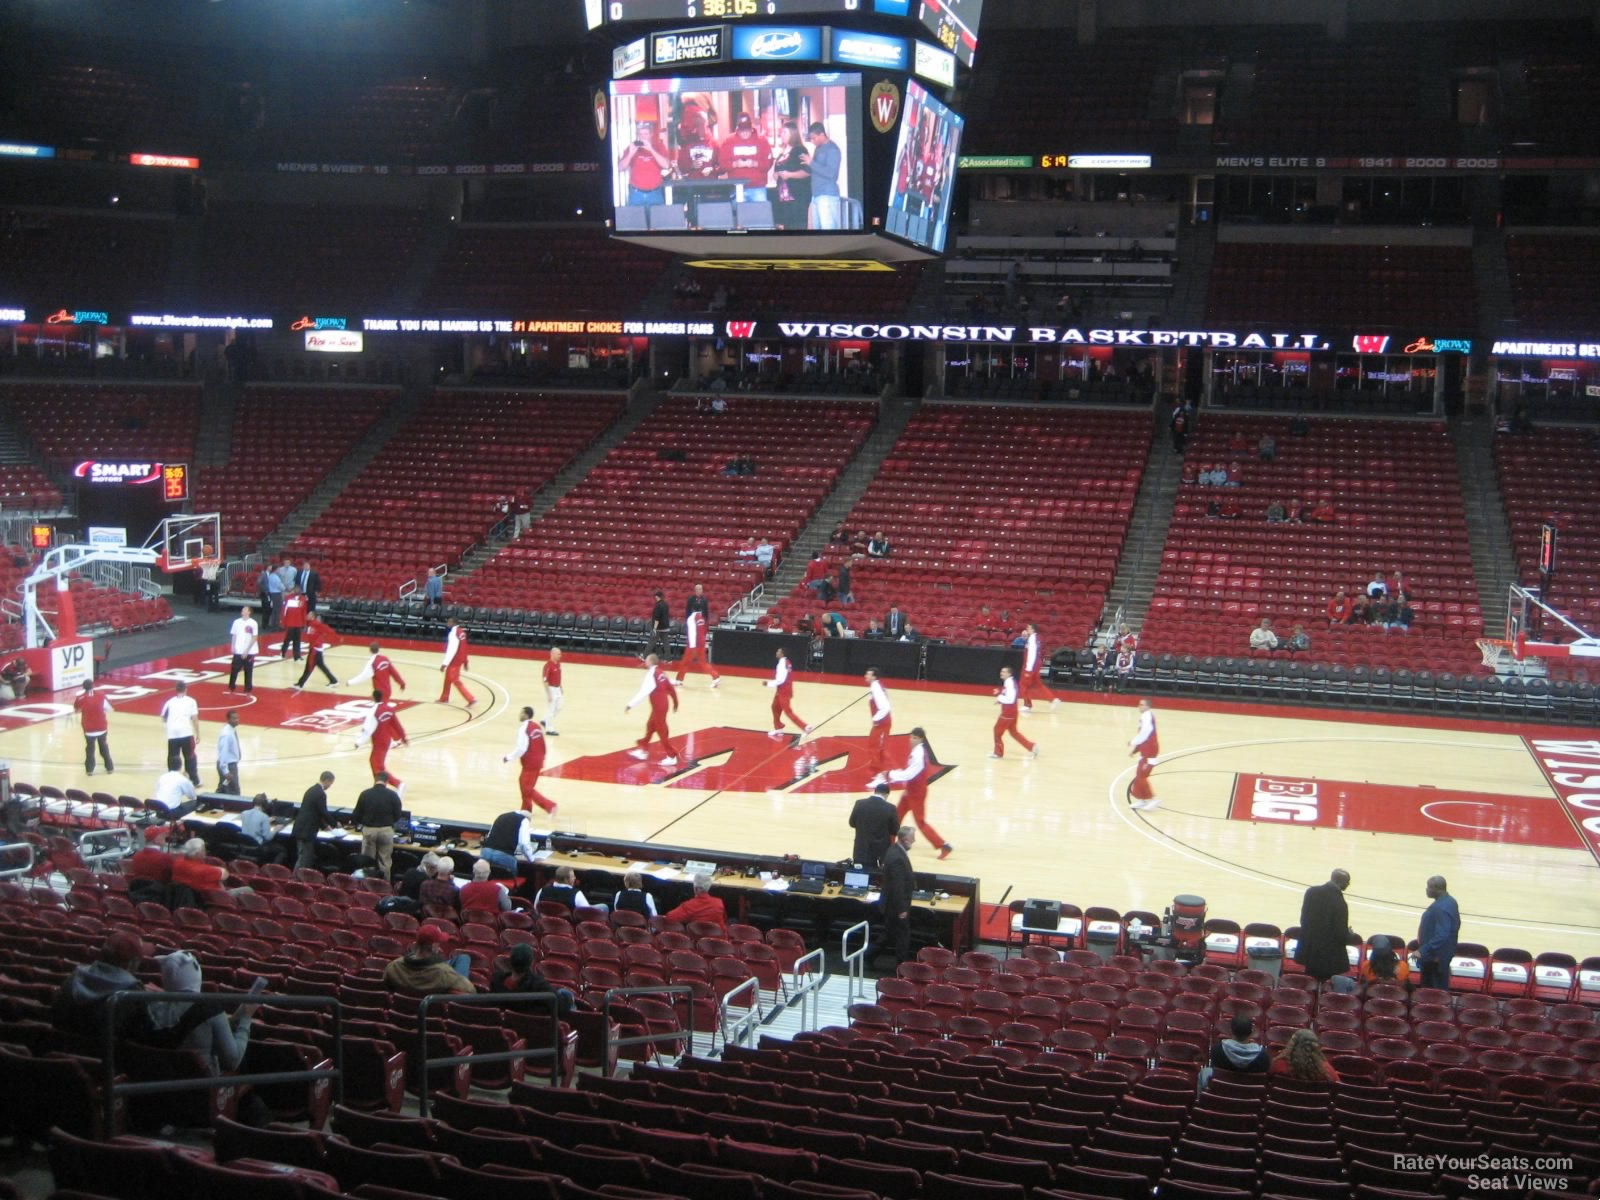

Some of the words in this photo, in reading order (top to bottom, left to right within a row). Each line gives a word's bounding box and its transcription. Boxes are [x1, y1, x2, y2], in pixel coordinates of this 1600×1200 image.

[677, 34, 718, 49] ALLIANT
[677, 46, 717, 60] ENERGY
[877, 97, 893, 122] W
[1041, 155, 1066, 167] 6:19
[1216, 157, 1264, 167] MEN'S
[1268, 158, 1309, 167] ELITE
[1315, 159, 1326, 167] 8
[1358, 158, 1393, 168] 1941
[1405, 159, 1447, 168] 2000
[1456, 159, 1498, 168] 2005
[131, 314, 273, 329] www.SteveBrownApts.com
[363, 319, 398, 331] THANK
[400, 320, 420, 331] YOU
[421, 320, 440, 331] FOR
[441, 320, 478, 332] MAKING
[480, 321, 493, 332] US
[494, 321, 513, 332] THE
[513, 321, 526, 332] #1
[528, 321, 585, 333] APARTMENT
[586, 321, 622, 333] CHOICE
[623, 321, 644, 334] FOR
[645, 322, 686, 335] BADGER
[687, 323, 715, 335] FANS
[777, 322, 1016, 342] WISCONSIN
[1028, 327, 1330, 350] BASKETBALL
[1491, 341, 1577, 356] APARTMENTS
[91, 463, 151, 477] SMART
[167, 478, 183, 497] 35
[62, 645, 85, 669] yp
